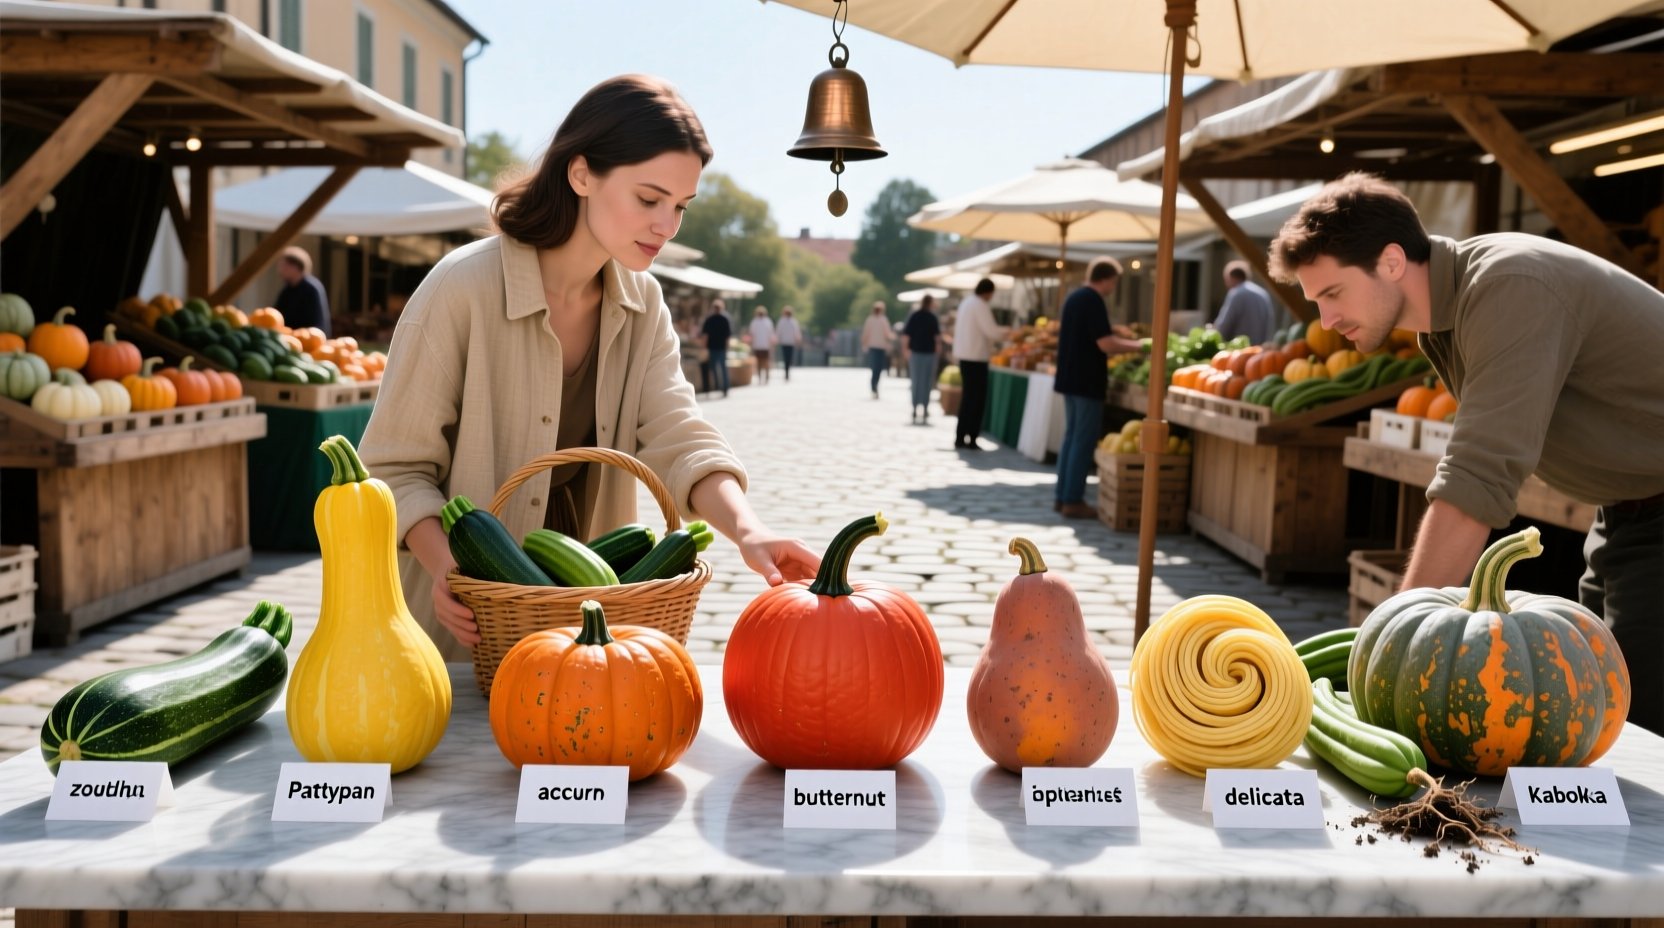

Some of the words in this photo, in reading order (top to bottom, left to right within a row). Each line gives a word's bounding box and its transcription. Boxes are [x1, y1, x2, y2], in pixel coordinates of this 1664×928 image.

[288, 780, 375, 805] Pattypan
[538, 787, 605, 801] accurn
[794, 787, 886, 806] butternut
[1225, 787, 1305, 806] delicata
